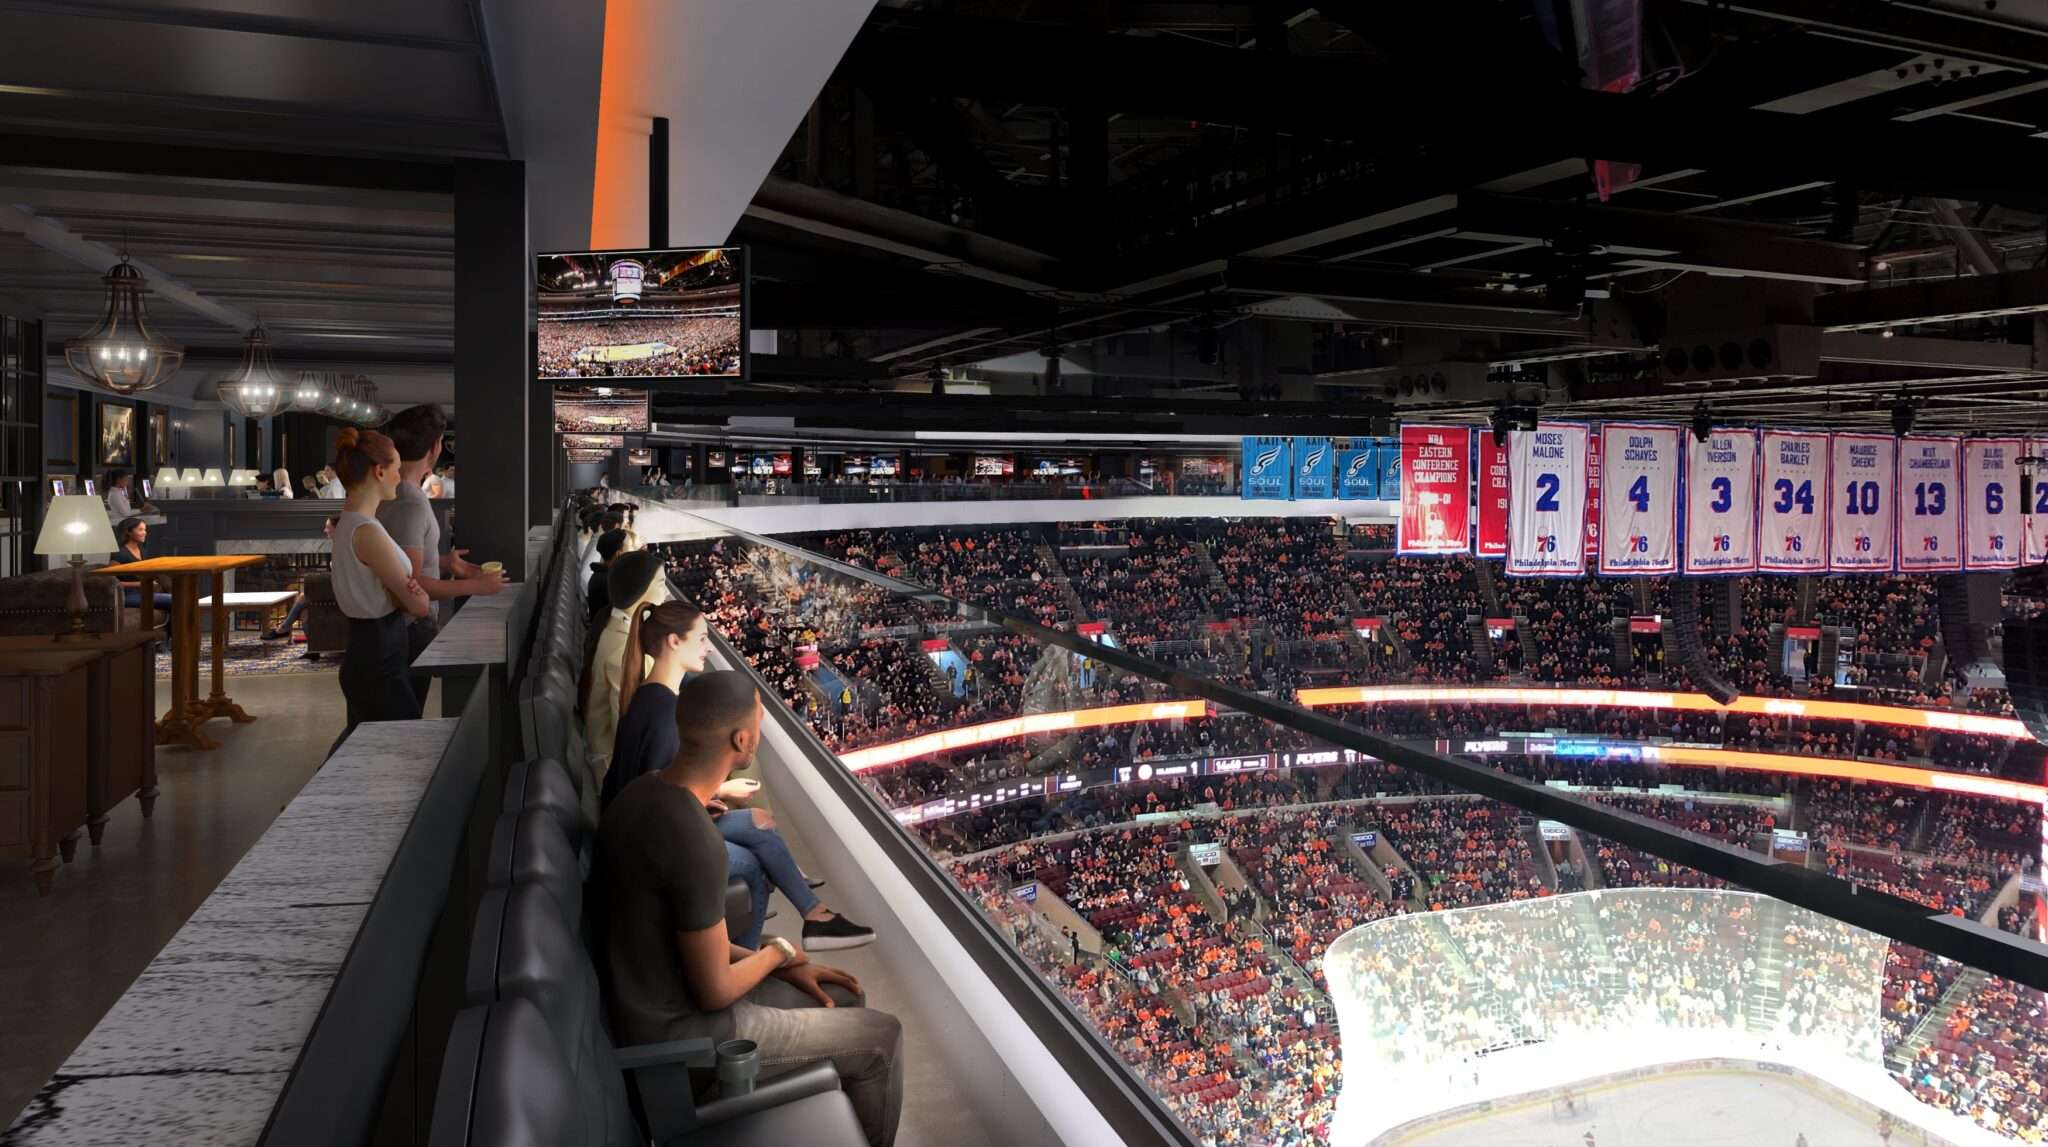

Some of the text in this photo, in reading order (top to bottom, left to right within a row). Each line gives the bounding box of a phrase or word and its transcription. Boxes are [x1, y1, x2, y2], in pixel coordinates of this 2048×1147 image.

[1427, 434, 1444, 446] NBA
[1535, 433, 1563, 445] MOSES
[1629, 436, 1653, 448] DOLPH
[1711, 439, 1733, 451] ALLEN
[1419, 446, 1452, 458] EASTERN
[1532, 446, 1564, 459] MALONE
[1780, 441, 1810, 453] CHARLES
[1624, 449, 1658, 461] SCHAYES
[1707, 452, 1737, 463] IVERSON
[1780, 453, 1810, 466] BARKLEY
[1412, 459, 1459, 471] CONFERENCE
[1248, 477, 1283, 486] SOUL
[1299, 477, 1328, 486] SOUL
[1343, 478, 1374, 487] SOUL
[1414, 471, 1457, 483] CHAMPIONS
[1536, 473, 1560, 512] 2
[1628, 475, 1650, 513] 4
[1711, 477, 1732, 513] 3
[1774, 478, 1814, 514] 34
[1846, 480, 1880, 515] 10
[1915, 482, 1946, 516] 13
[1985, 482, 2004, 515] 6
[1537, 535, 1556, 552] 76
[1631, 535, 1648, 552] 76
[1713, 535, 1730, 552] 76
[1785, 536, 1802, 552] 76
[1855, 536, 1871, 552] 76
[1923, 536, 1938, 551] 76
[1989, 535, 2004, 551] 76
[1514, 559, 1577, 568] Philadelphia 76ers
[1464, 741, 1508, 752] FLYERS
[1296, 751, 1338, 765] FLYERS
